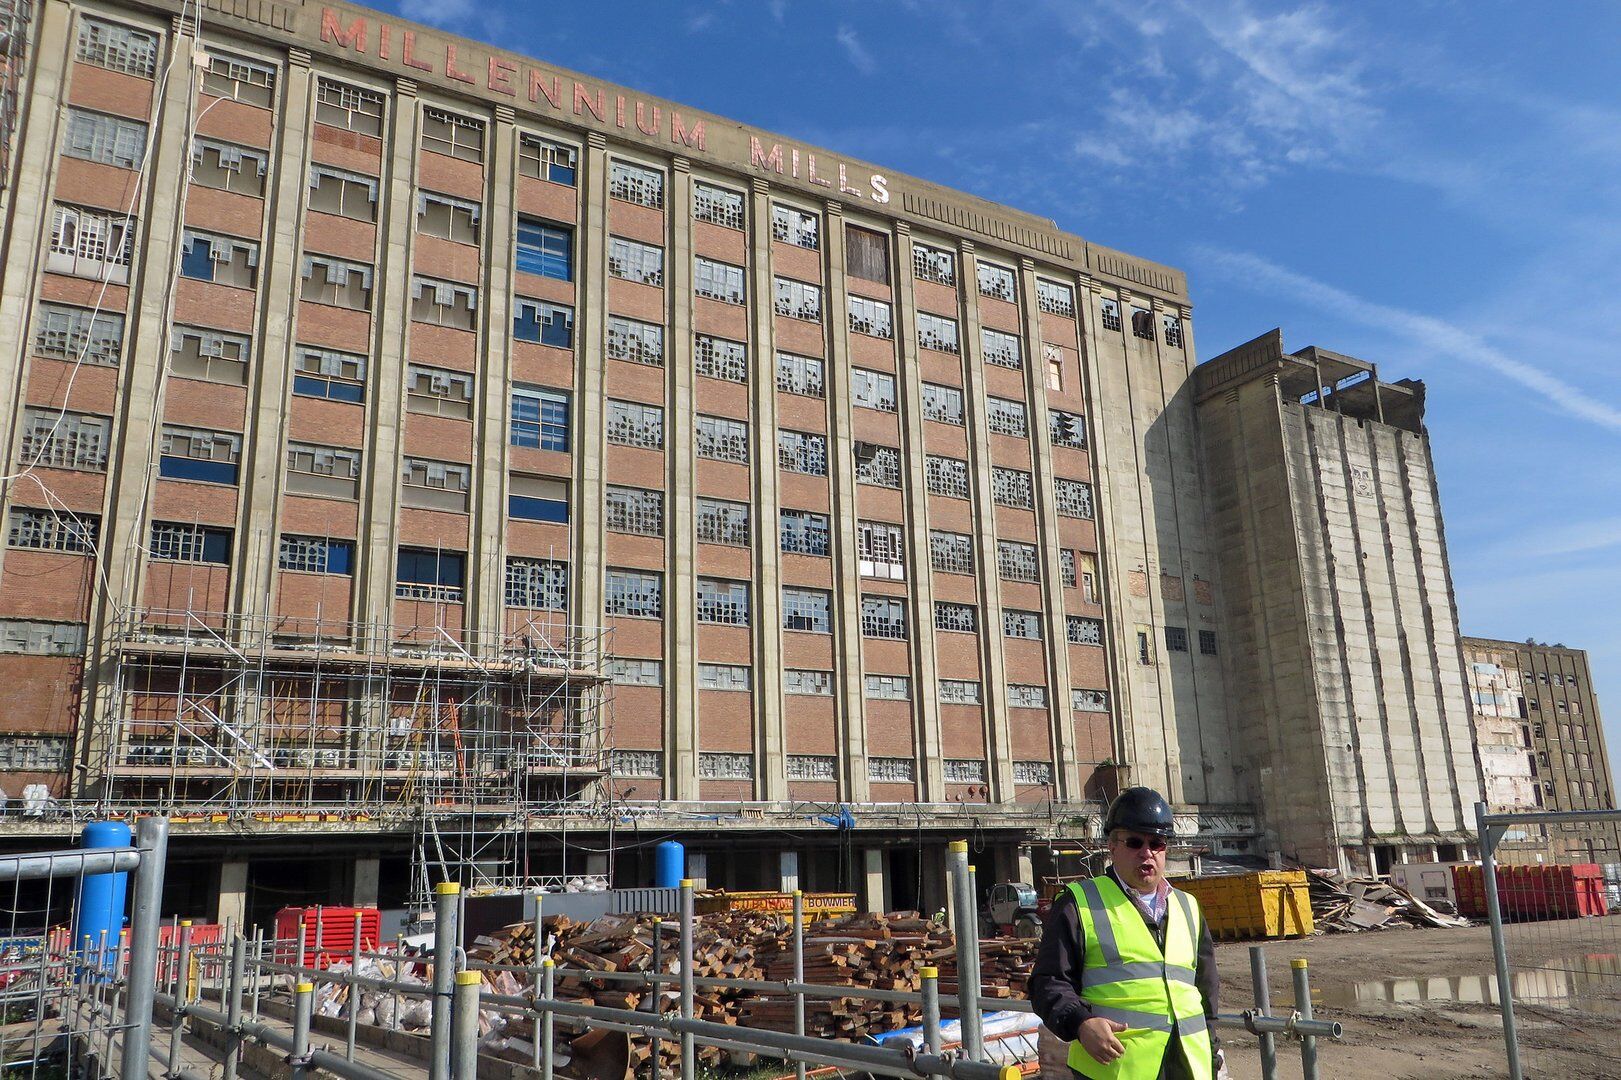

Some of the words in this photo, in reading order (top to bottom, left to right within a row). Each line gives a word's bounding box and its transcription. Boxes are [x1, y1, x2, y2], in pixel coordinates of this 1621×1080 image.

[320, 7, 705, 151] MILLENNIUM
[750, 136, 889, 204] MILLS
[809, 898, 855, 908] BOWMER
